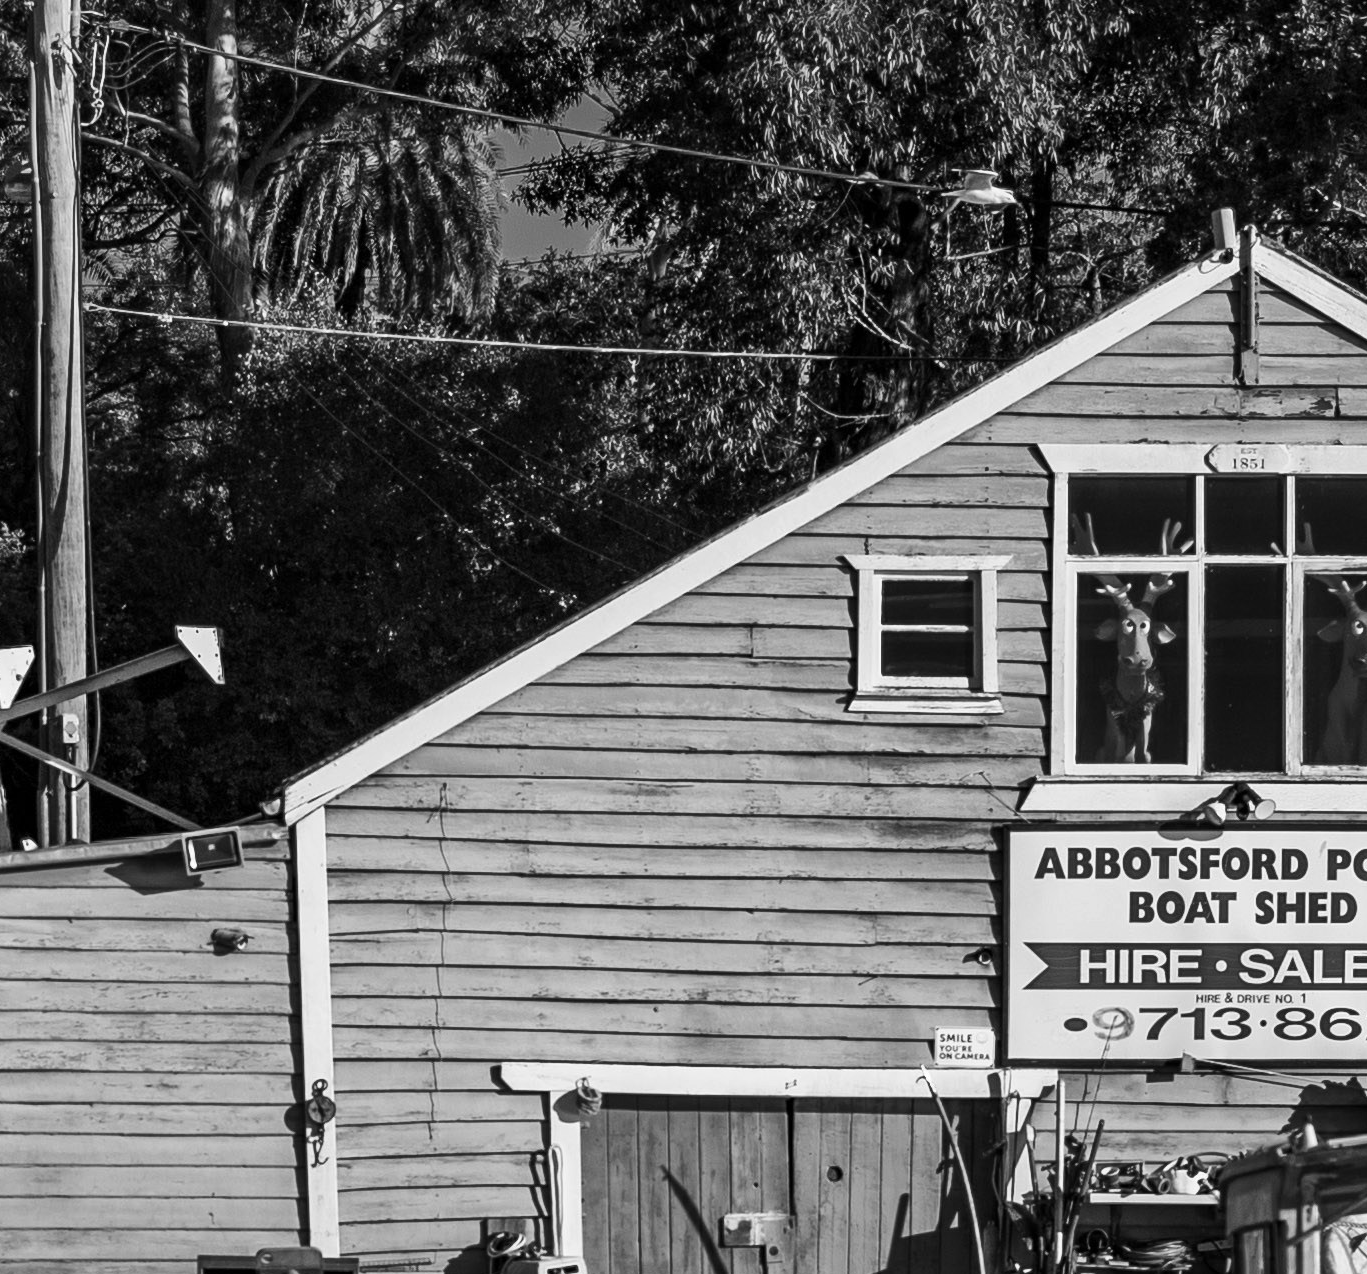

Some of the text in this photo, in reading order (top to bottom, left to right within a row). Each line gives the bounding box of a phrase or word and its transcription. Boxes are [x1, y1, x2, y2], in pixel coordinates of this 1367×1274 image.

[1232, 457, 1265, 470] 1851
[1034, 846, 1309, 881] ABBOTSFORD
[1128, 890, 1358, 925] BOAT SHED
[1079, 949, 1203, 984] HIRE
[1195, 993, 1221, 1004] HIRE
[1224, 991, 1234, 1004] &
[1236, 993, 1271, 1004] DRIVE
[1300, 992, 1307, 1004] 1
[939, 1033, 973, 1043] SMILE
[939, 1052, 952, 1060] ON
